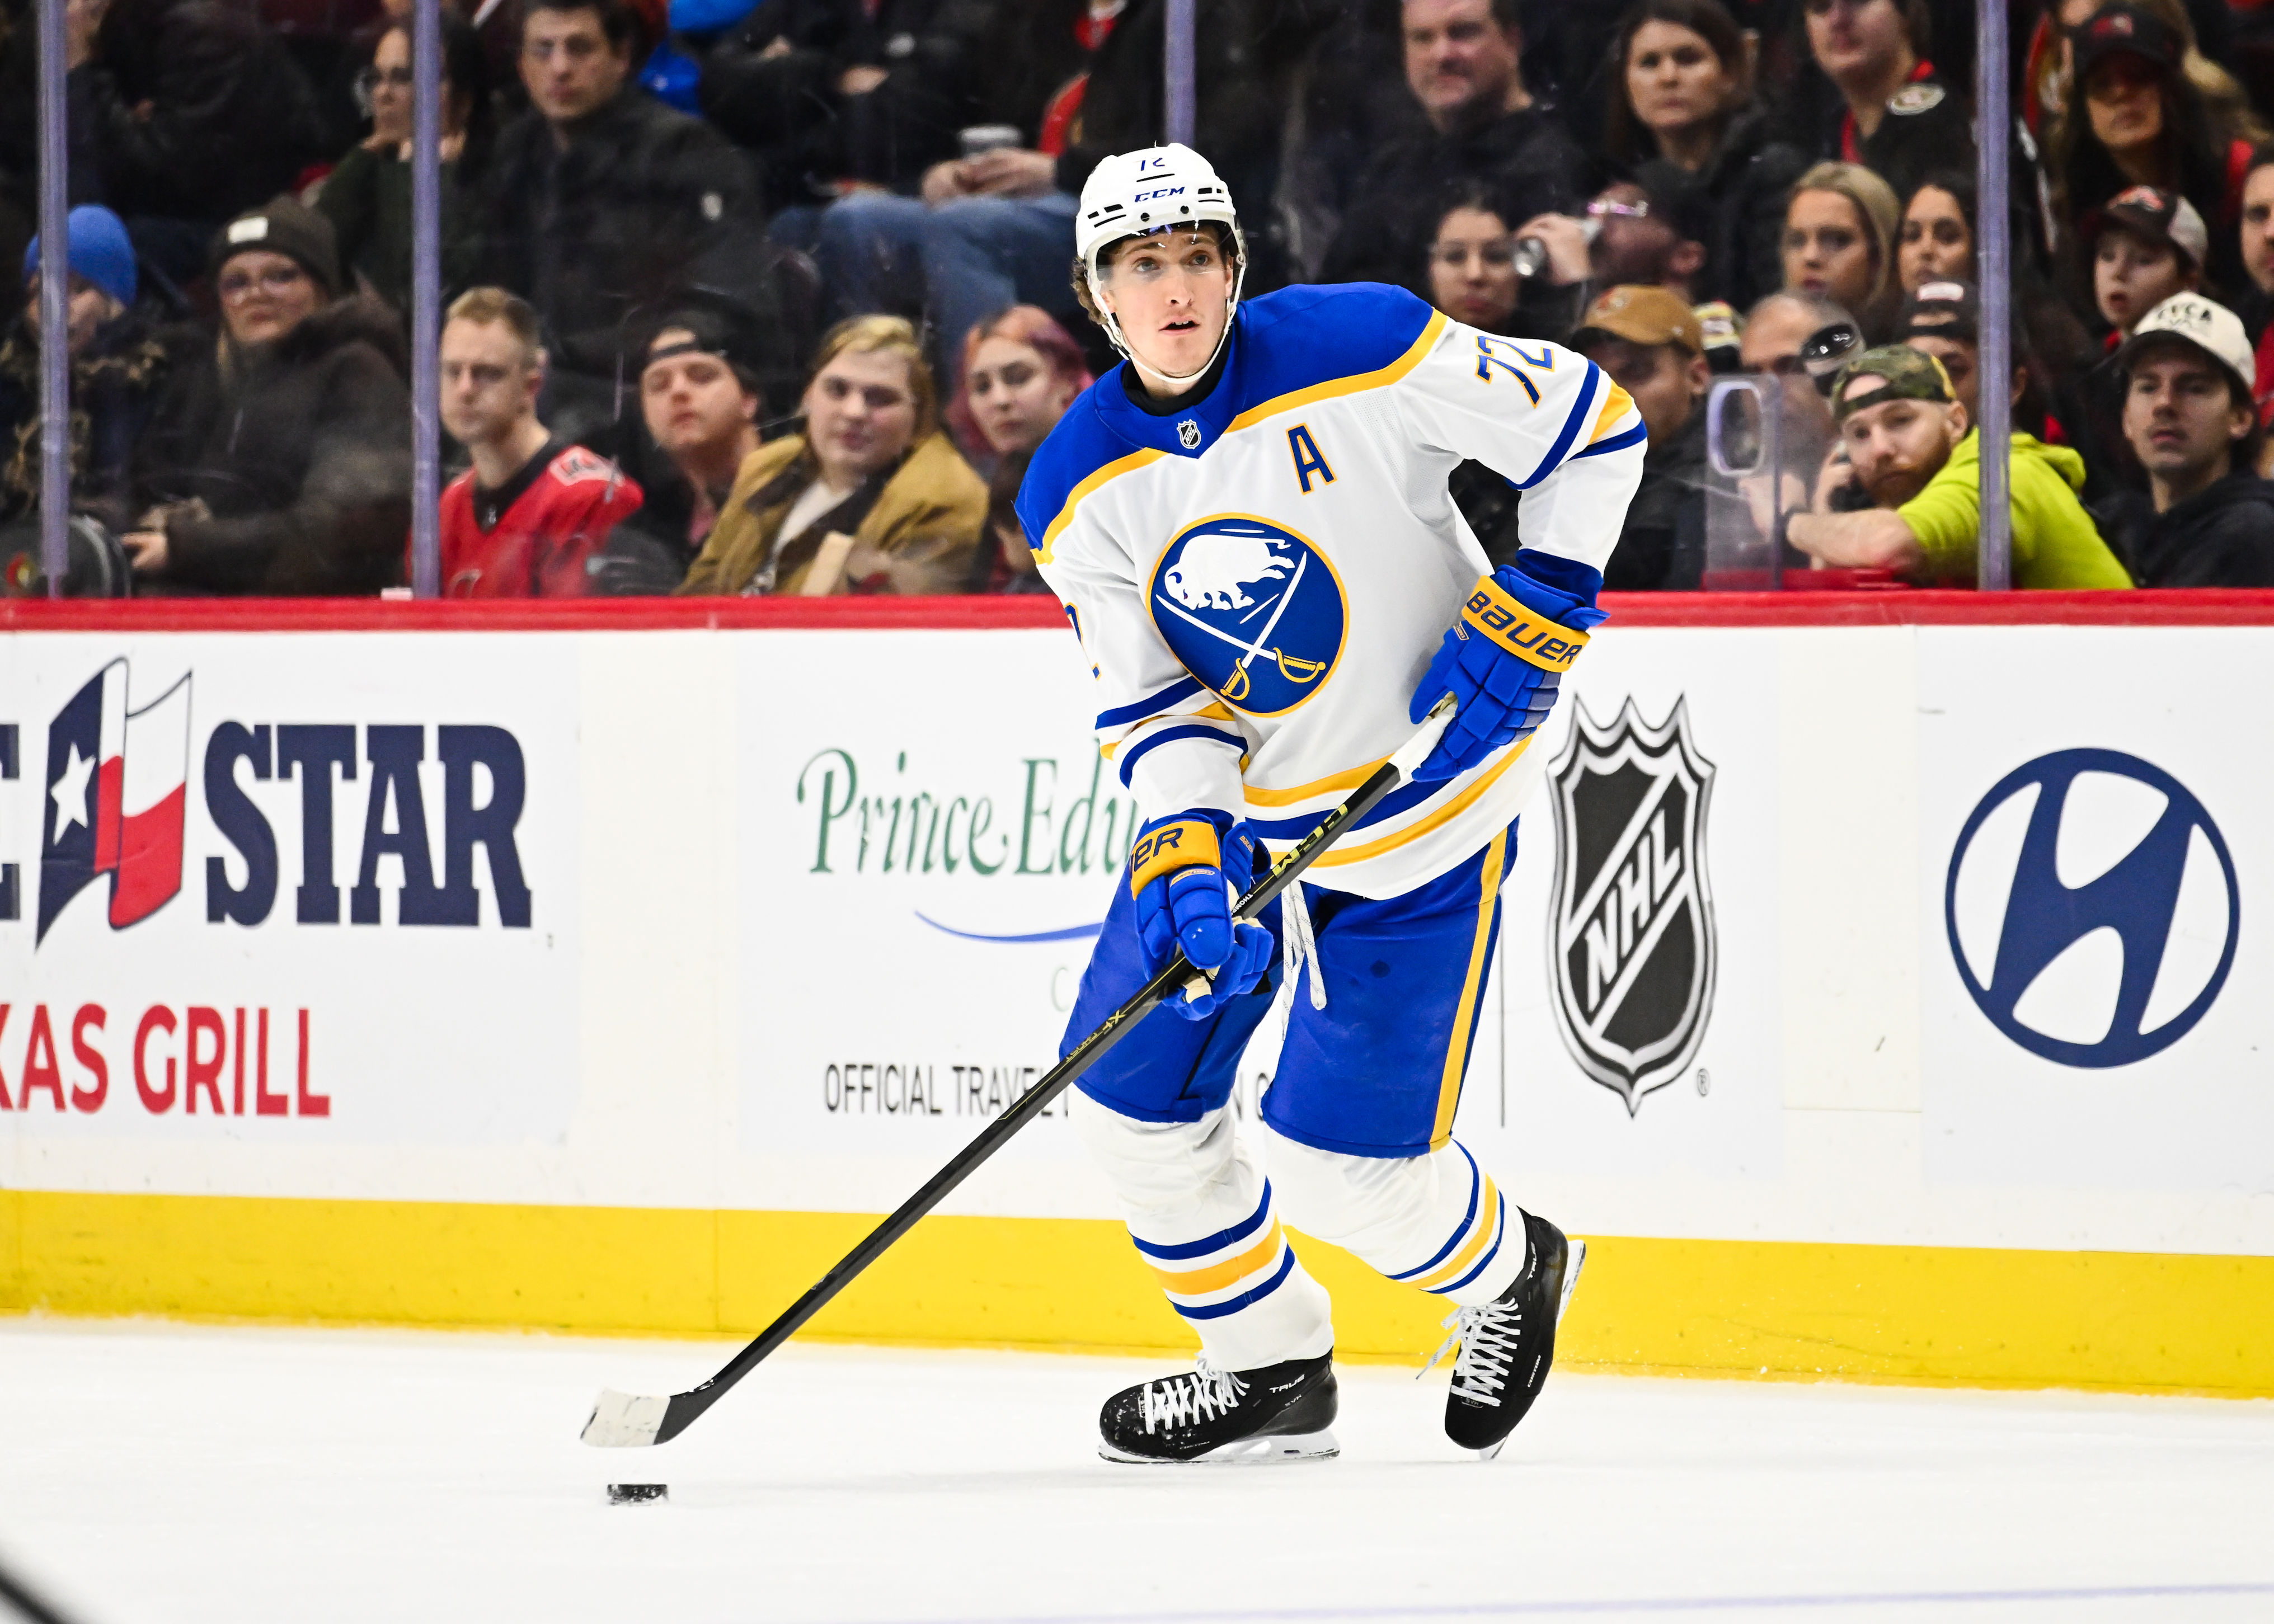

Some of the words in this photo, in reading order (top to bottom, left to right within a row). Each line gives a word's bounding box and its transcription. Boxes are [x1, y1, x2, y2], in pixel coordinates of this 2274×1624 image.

[1134, 186, 1185, 203] CCM
[1476, 336, 1554, 409] 72
[1287, 422, 1337, 496] A
[204, 719, 532, 929] STAR
[797, 747, 1009, 876] Prince
[1585, 809, 1680, 1012] NHL
[133, 1003, 331, 1117] GRILL
[826, 1064, 942, 1115] OFFICIAL
[1269, 1373, 1305, 1394] TRUE
